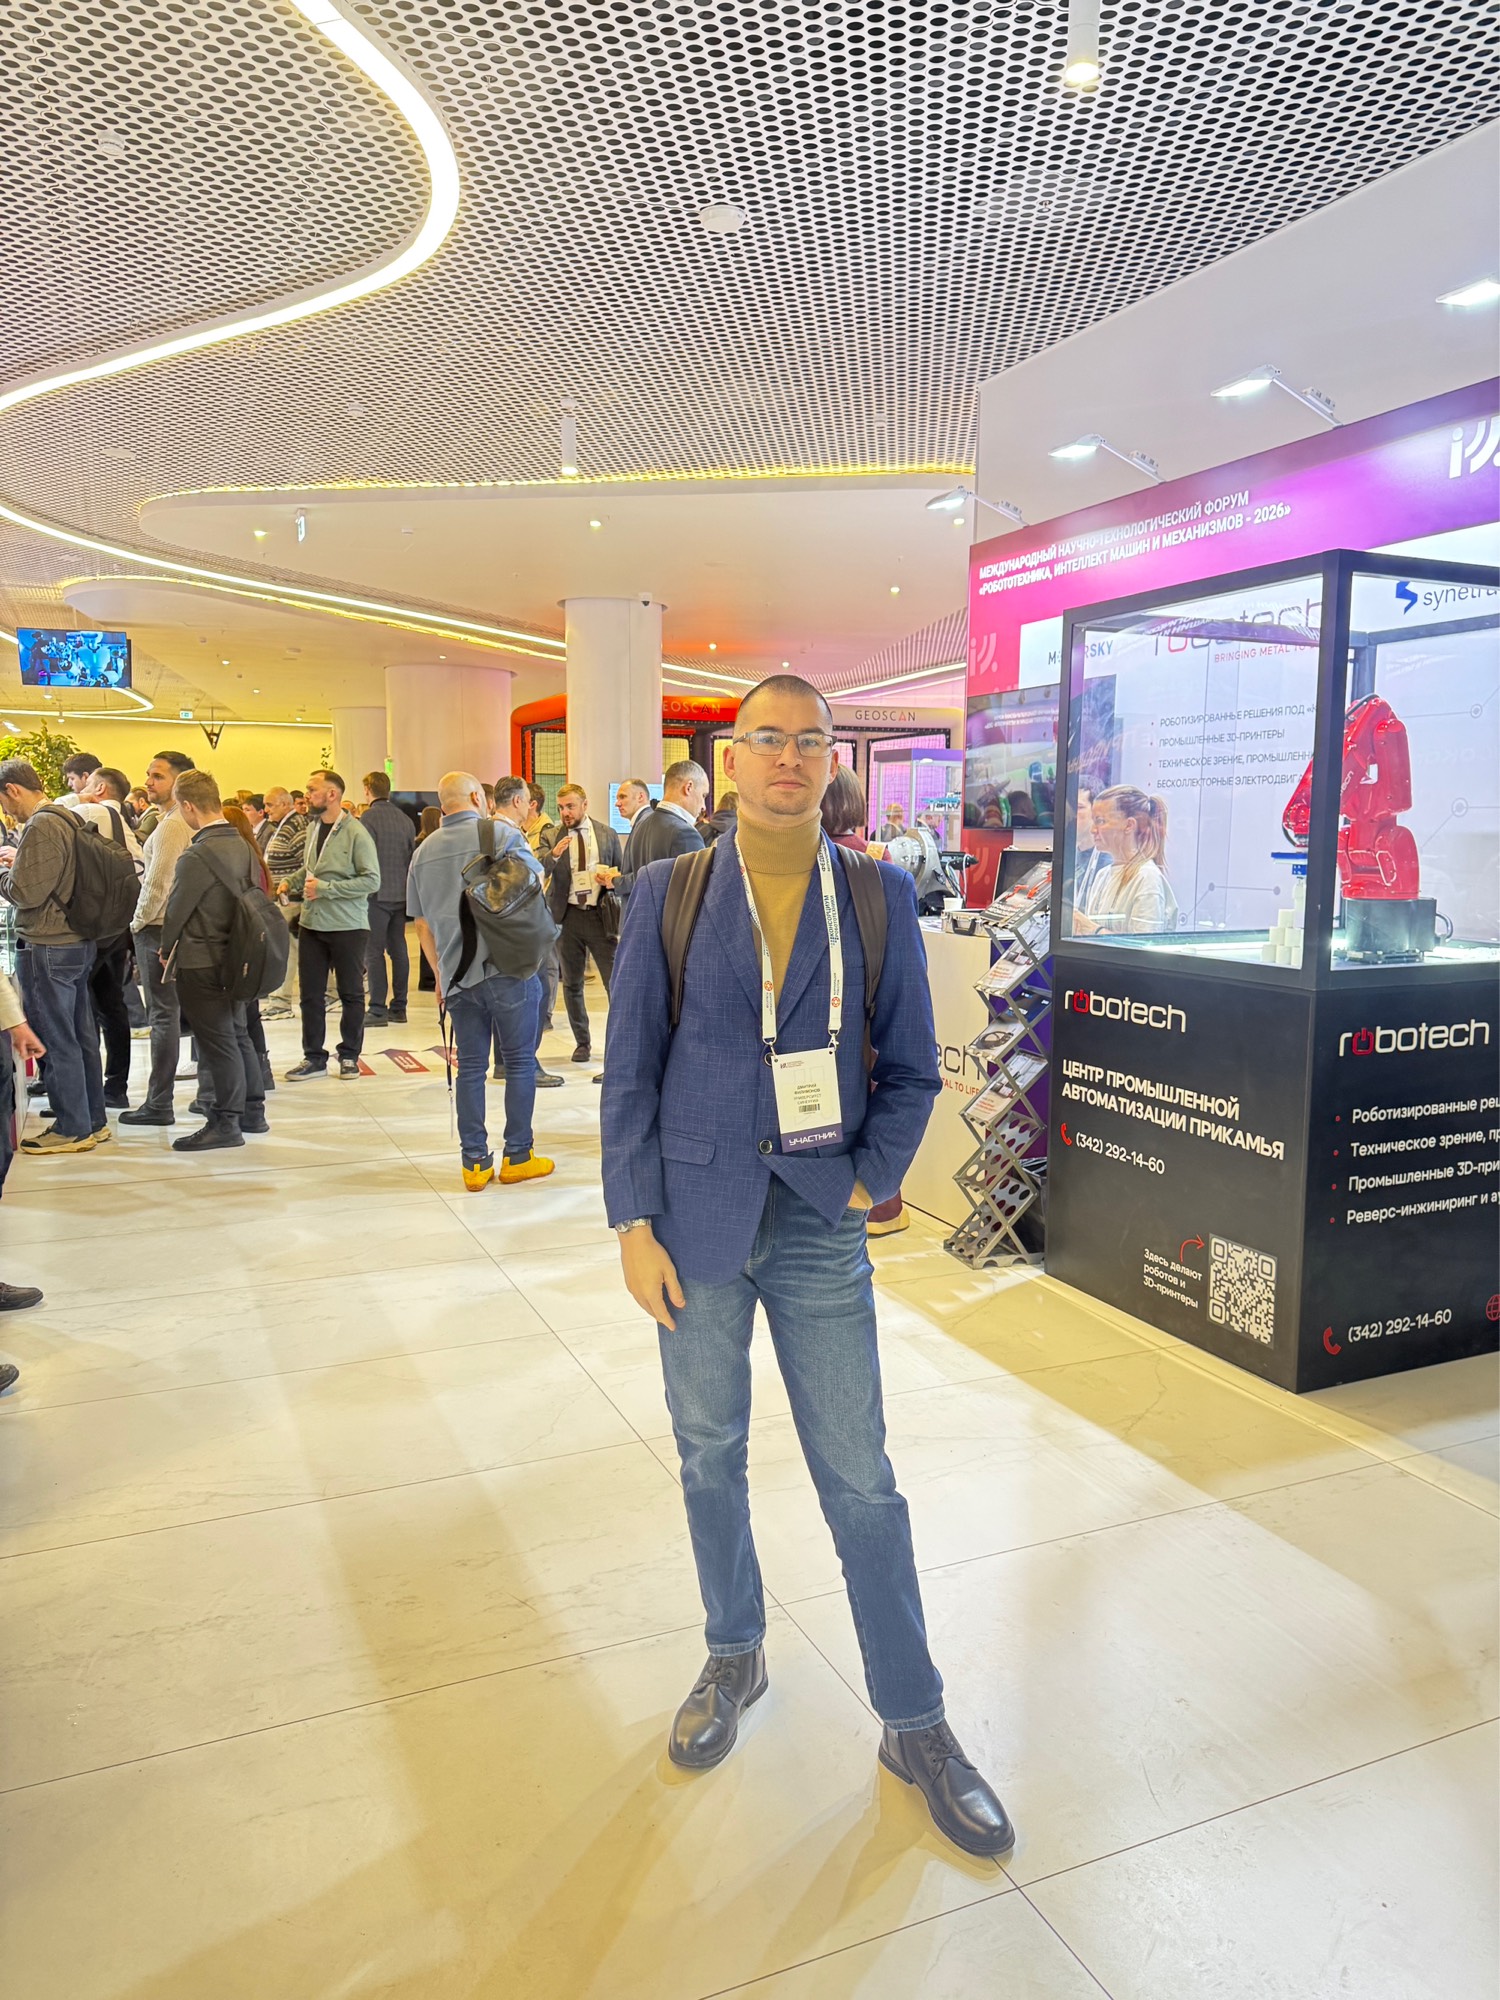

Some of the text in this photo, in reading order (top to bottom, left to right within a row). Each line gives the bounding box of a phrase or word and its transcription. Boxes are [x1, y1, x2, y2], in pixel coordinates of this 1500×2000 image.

[979, 490, 1249, 580] МЕЖДУНАРОДНЫЙ НАУЧНО-ТЕХНОЛОГИЧЕСКИЙ ФОРУМ
[1053, 550, 1110, 577] ИНТЕЛЛЕКТ
[1110, 540, 1150, 563] МАШИН
[1151, 537, 1161, 551] И
[1161, 513, 1244, 549] МЕХАНИЗМОВ
[1253, 502, 1291, 525] 2026»
[1214, 648, 1257, 663] BRINGING
[1259, 644, 1290, 657] METAL
[662, 700, 720, 714] EOSCAN
[854, 709, 916, 722] GEOSCAN
[1243, 706, 1283, 720] РЕШЕНИЯ
[1284, 704, 1305, 717] ПОД
[1159, 729, 1285, 748] ПРОМЫШЛЕННЫЕ 3D-ПРИНТЕРЫ
[1158, 756, 1212, 769] ТЕХНИЧЕСКОЕ
[1246, 751, 1313, 764] ПРОМЫШЛЕНН
[1157, 774, 1303, 789] БЕСКОЛЛЕКТОРНЫЕ ЭЛЕКТРОДВИГ
[1064, 989, 1187, 1033] robotech
[1338, 1018, 1490, 1057] robotech
[954, 1081, 965, 1093] TO
[1062, 1058, 1241, 1121] ЦЕНТР ПРОМЫШЛЕННОЙ
[1061, 1082, 1285, 1161] АВТОМАТИЗАЦИИ ПРИКАМЬЯ
[1352, 1098, 1477, 1124] Роботизированные
[788, 1130, 837, 1146] УЧАСТНИК
[1350, 1136, 1437, 1158] Техническое
[1439, 1130, 1486, 1150] зрение,
[1075, 1131, 1165, 1175] (342) 292-14-60
[1348, 1166, 1454, 1193] Промышленные
[1346, 1194, 1478, 1225] Реверс-инжиниринг
[1480, 1193, 1489, 1205] и
[1143, 1248, 1203, 1281] Здесь делают
[1143, 1264, 1186, 1289] роботов и
[1143, 1275, 1199, 1309] 3D-принтеры
[1347, 1308, 1453, 1343] (342) 292-14-60
